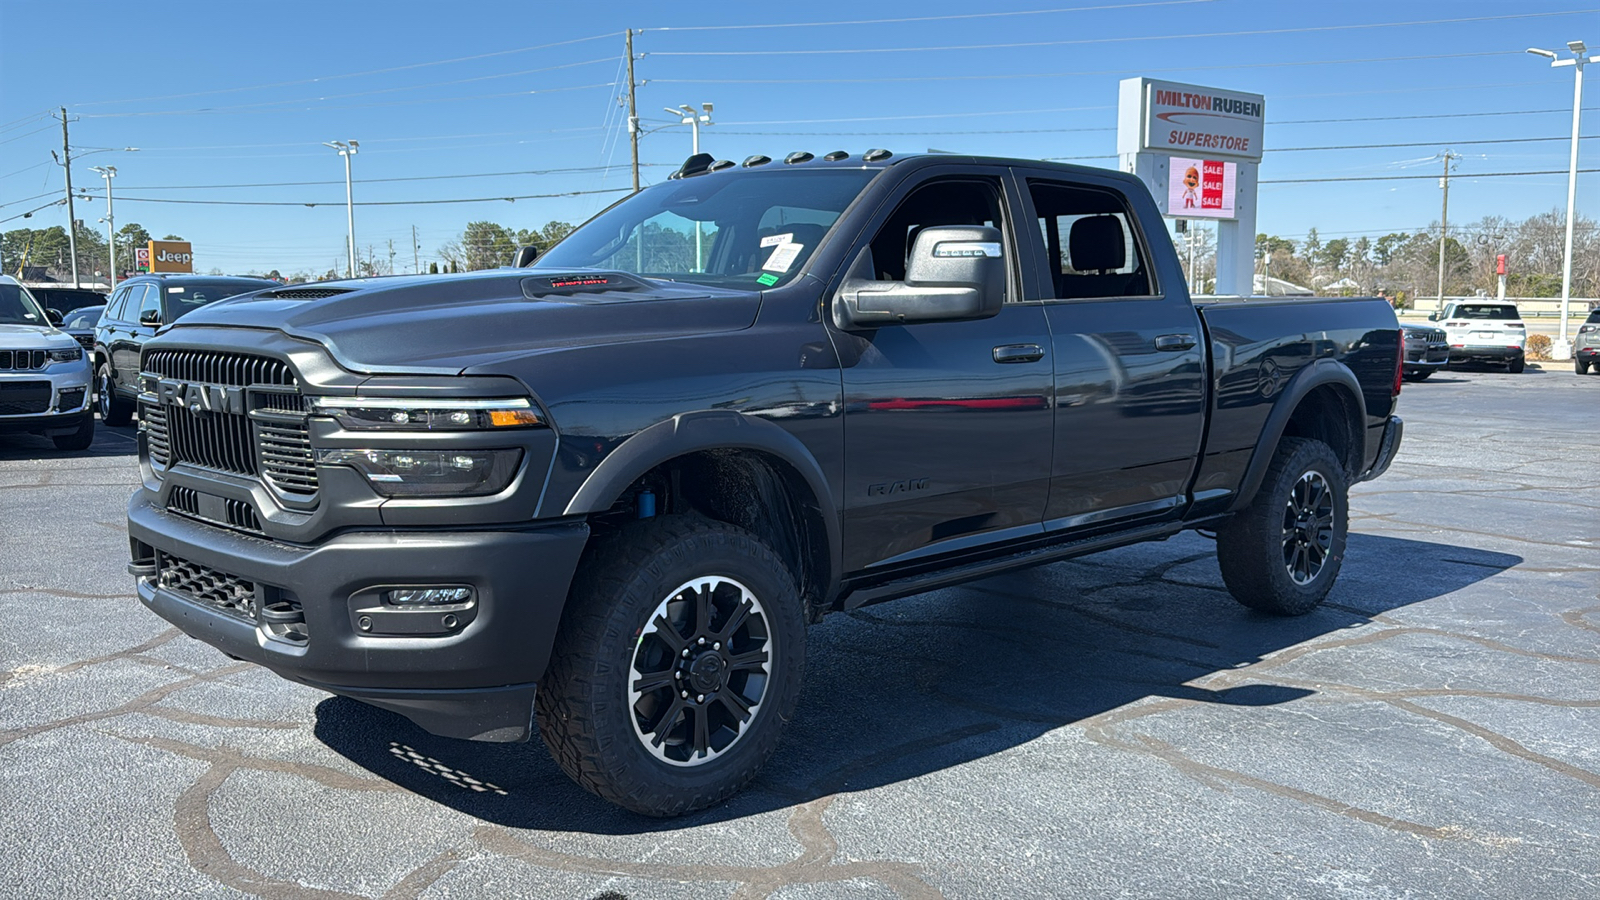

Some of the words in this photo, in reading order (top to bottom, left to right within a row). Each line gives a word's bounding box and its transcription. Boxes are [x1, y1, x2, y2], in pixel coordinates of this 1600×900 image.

[1156, 90, 1212, 110] MILTON
[1212, 97, 1261, 117] RUBEN
[1168, 130, 1249, 151] SUPERSTORE
[1203, 165, 1223, 175] SALE!
[1203, 181, 1222, 190] SALE!
[1202, 197, 1221, 206] SALE!
[156, 249, 191, 265] Jeep
[158, 380, 244, 415] RAM
[867, 477, 930, 497] RAM
